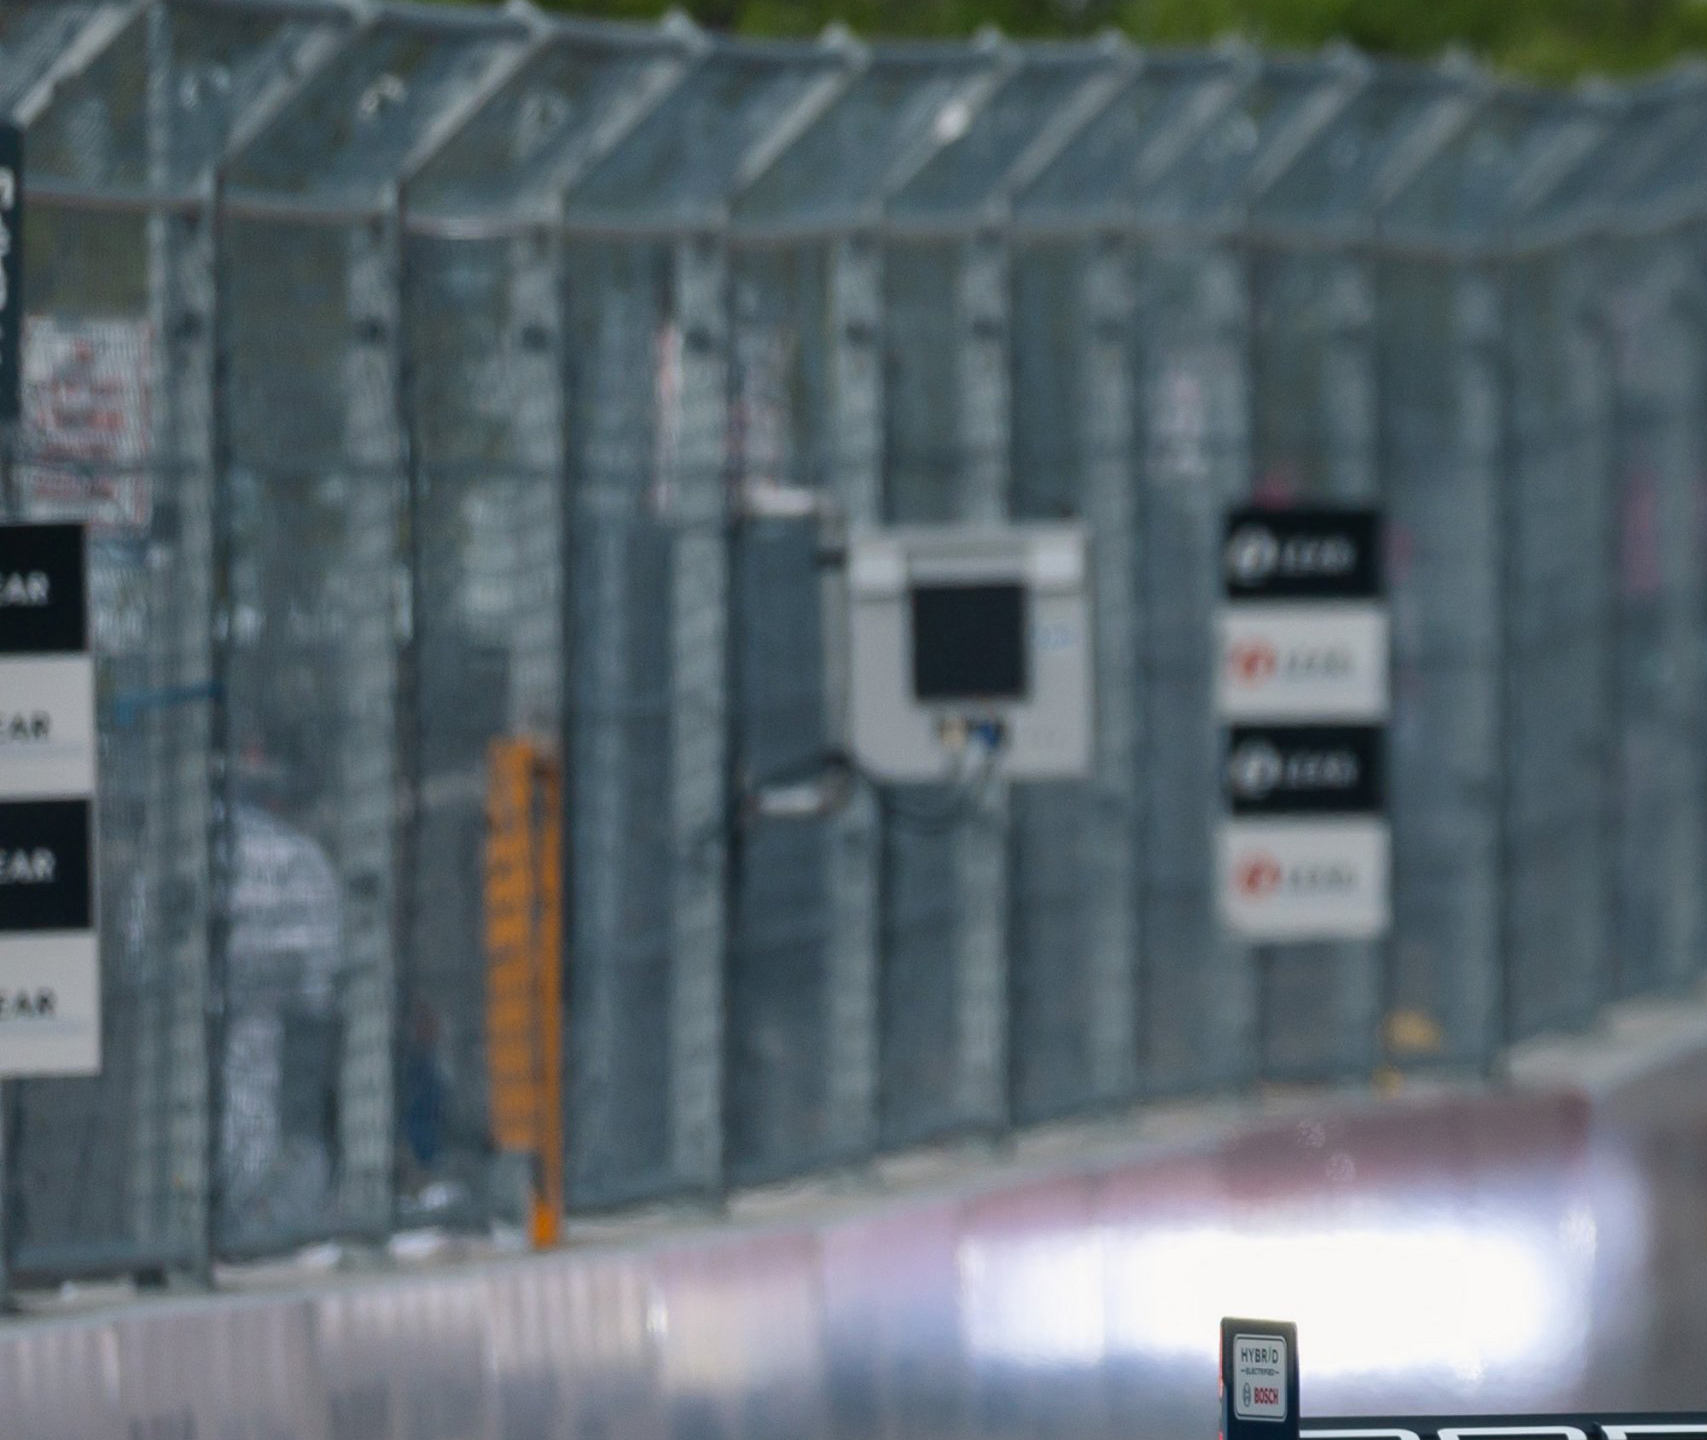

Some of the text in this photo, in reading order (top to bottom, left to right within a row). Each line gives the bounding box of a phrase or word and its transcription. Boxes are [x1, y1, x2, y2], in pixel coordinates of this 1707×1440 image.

[0, 571, 51, 607] AR
[0, 710, 52, 741] AR
[1254, 1387, 1279, 1405] BOSCH
